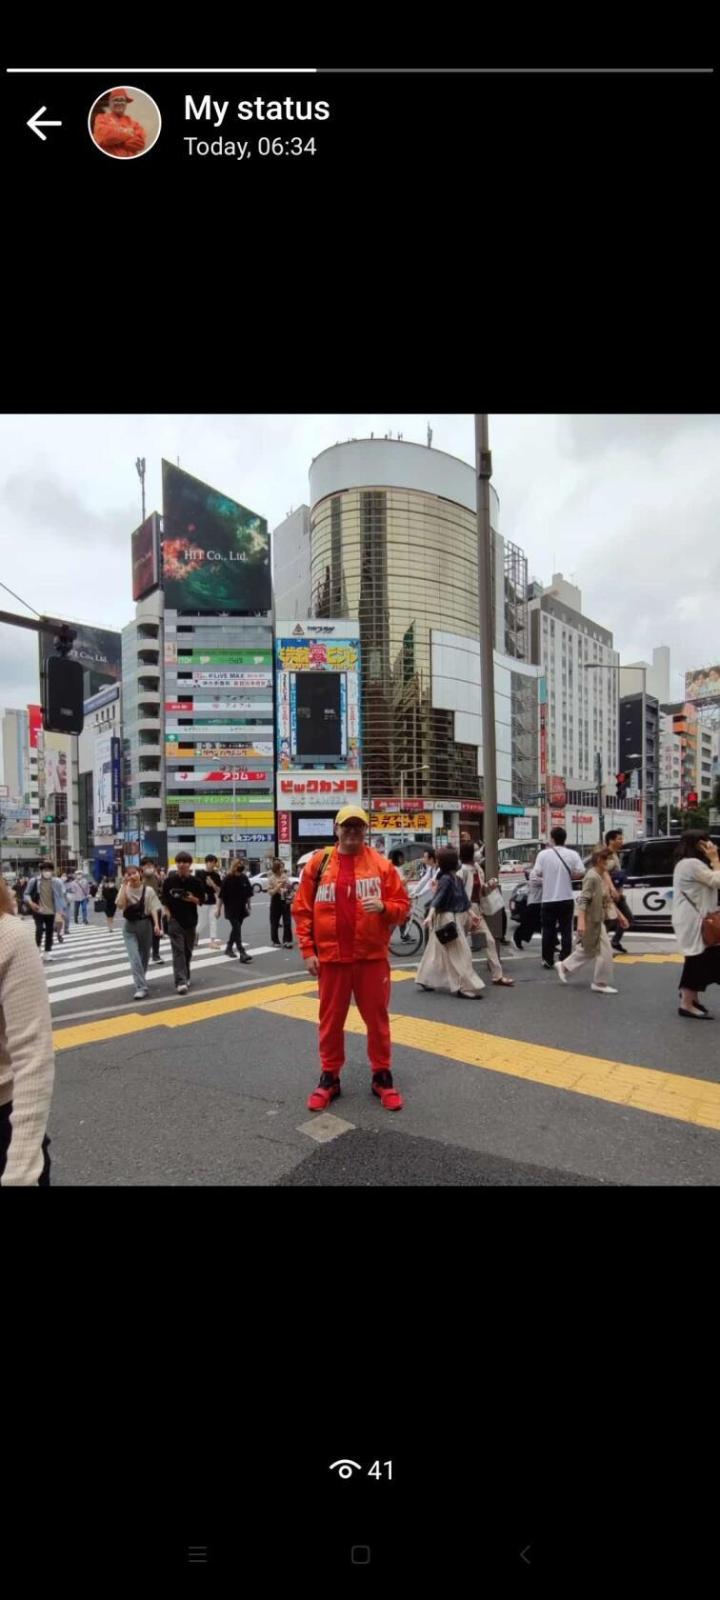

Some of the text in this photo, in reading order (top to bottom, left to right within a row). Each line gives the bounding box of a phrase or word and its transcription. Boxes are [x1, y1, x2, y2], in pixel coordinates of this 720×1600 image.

[222, 771, 248, 781] アコム
[280, 779, 359, 794] ビックカメラ
